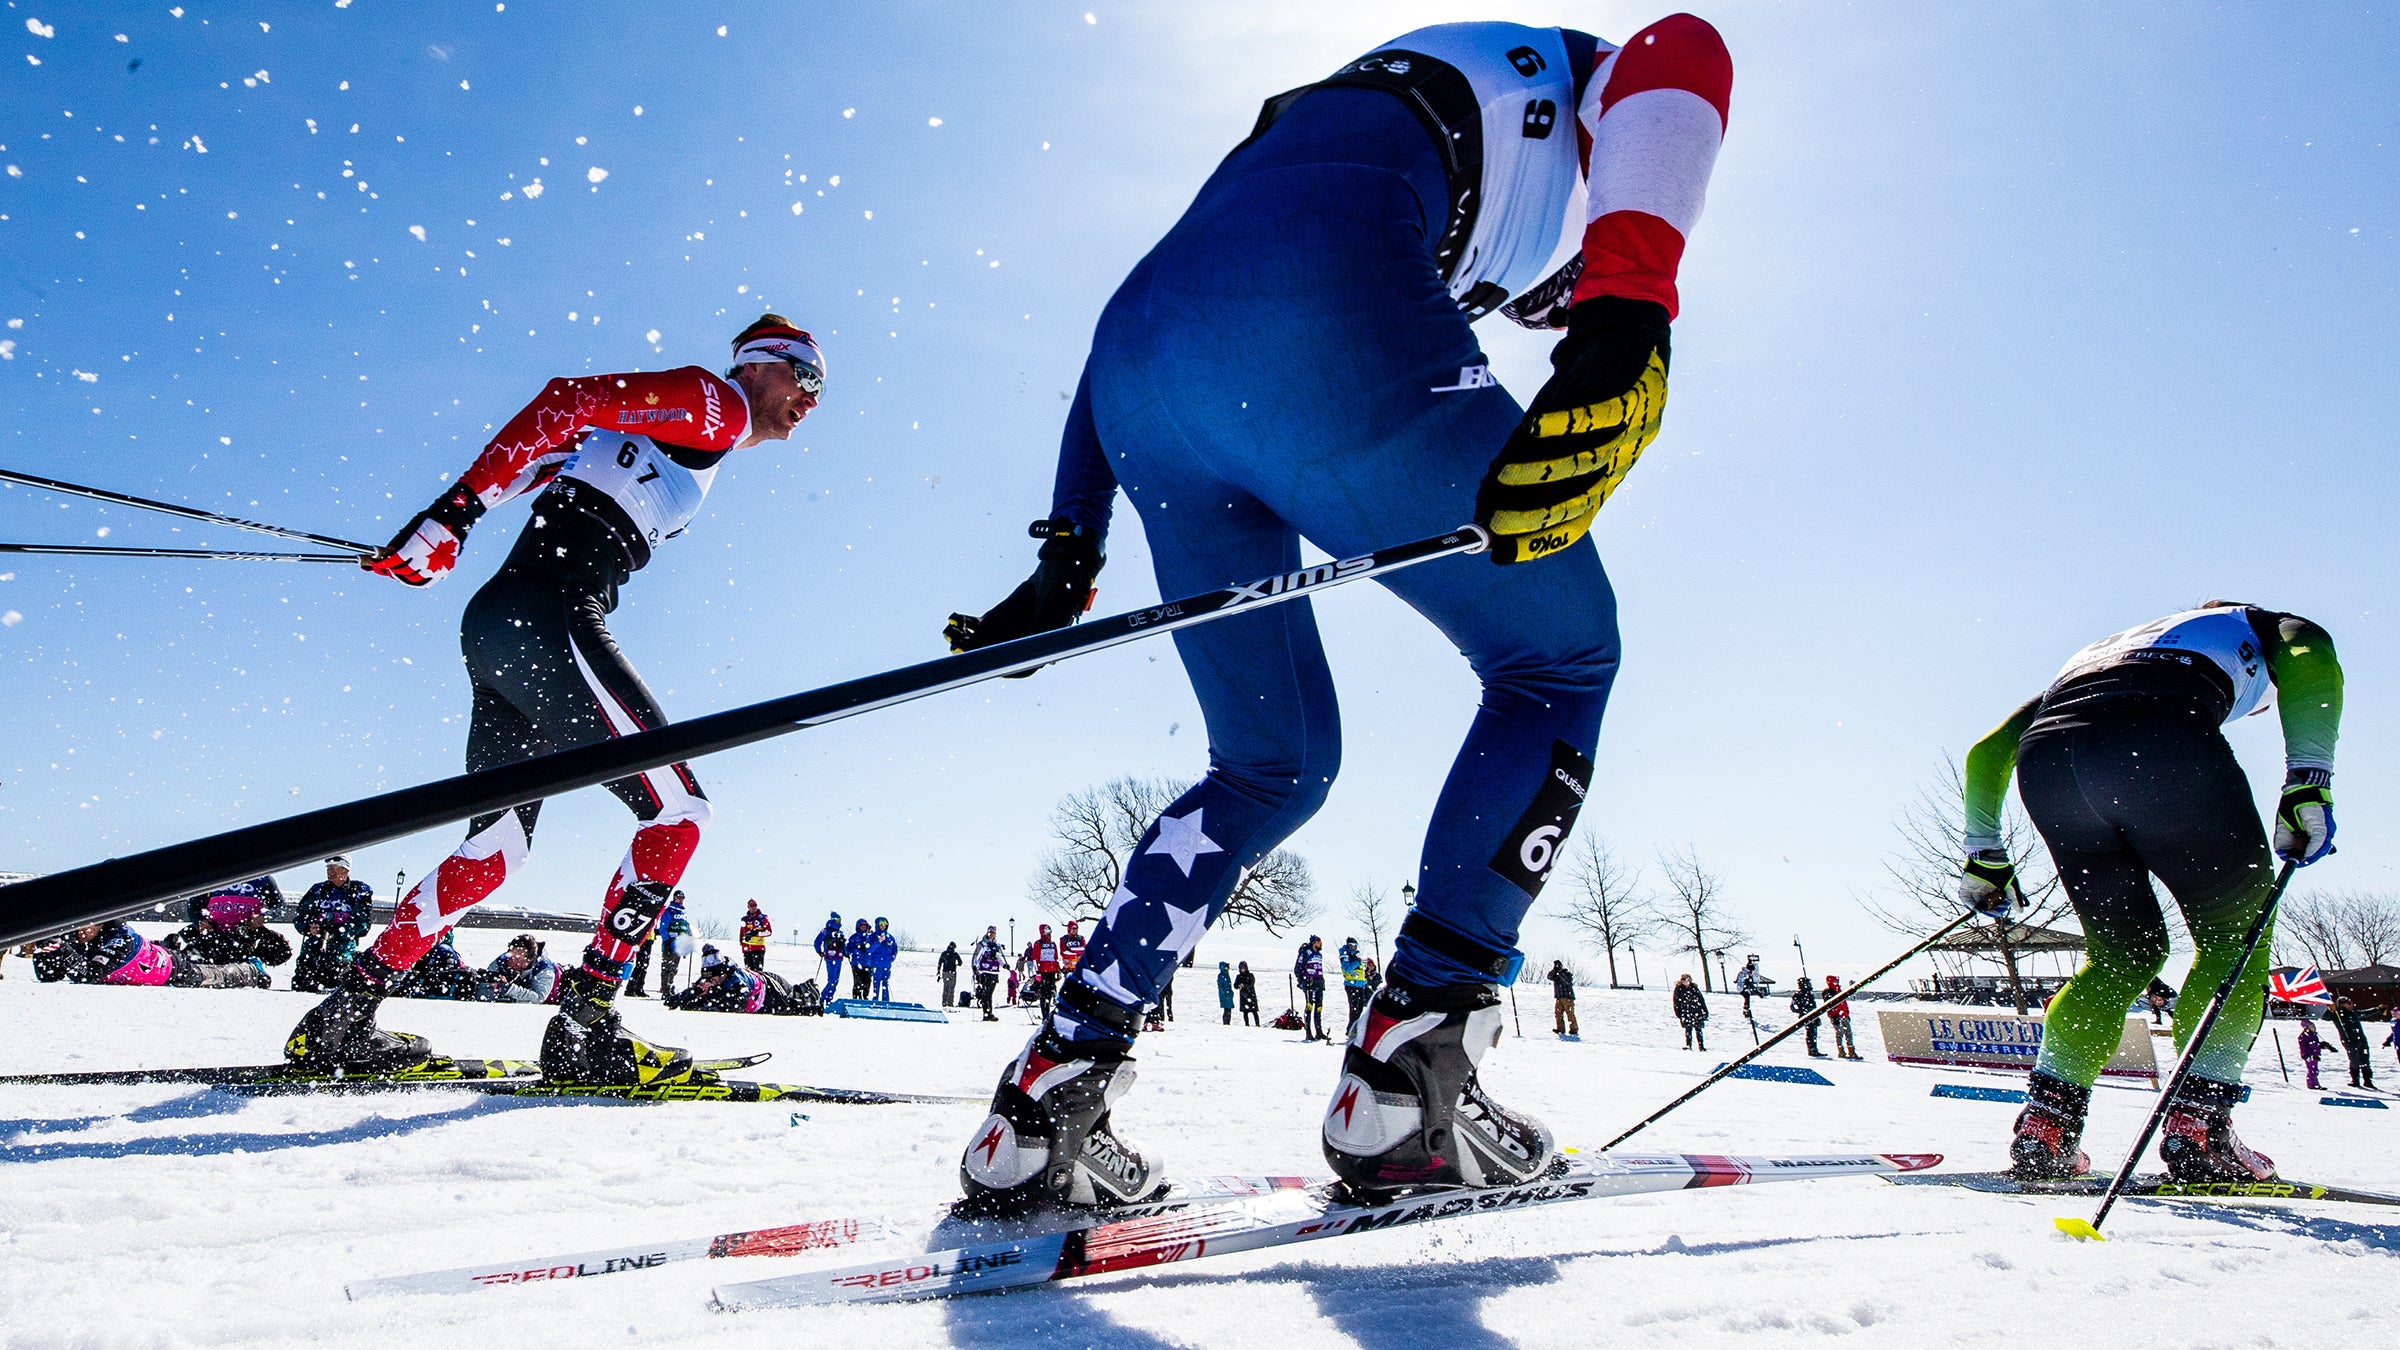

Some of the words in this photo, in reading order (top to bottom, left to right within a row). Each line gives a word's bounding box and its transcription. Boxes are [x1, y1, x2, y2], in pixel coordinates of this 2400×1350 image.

[617, 408, 688, 424] HAYWOOD
[1528, 532, 1569, 554] TOKO
[612, 907, 653, 938] 67
[1927, 1018, 1955, 1040] LE
[1959, 1017, 2044, 1044] GRUYÈR
[1938, 1041, 2041, 1056] SWITZERLA
[2154, 1181, 2296, 1199] FISCHER
[1342, 1181, 1596, 1235] MADSHUS
[829, 1249, 1022, 1288] REDLINE
